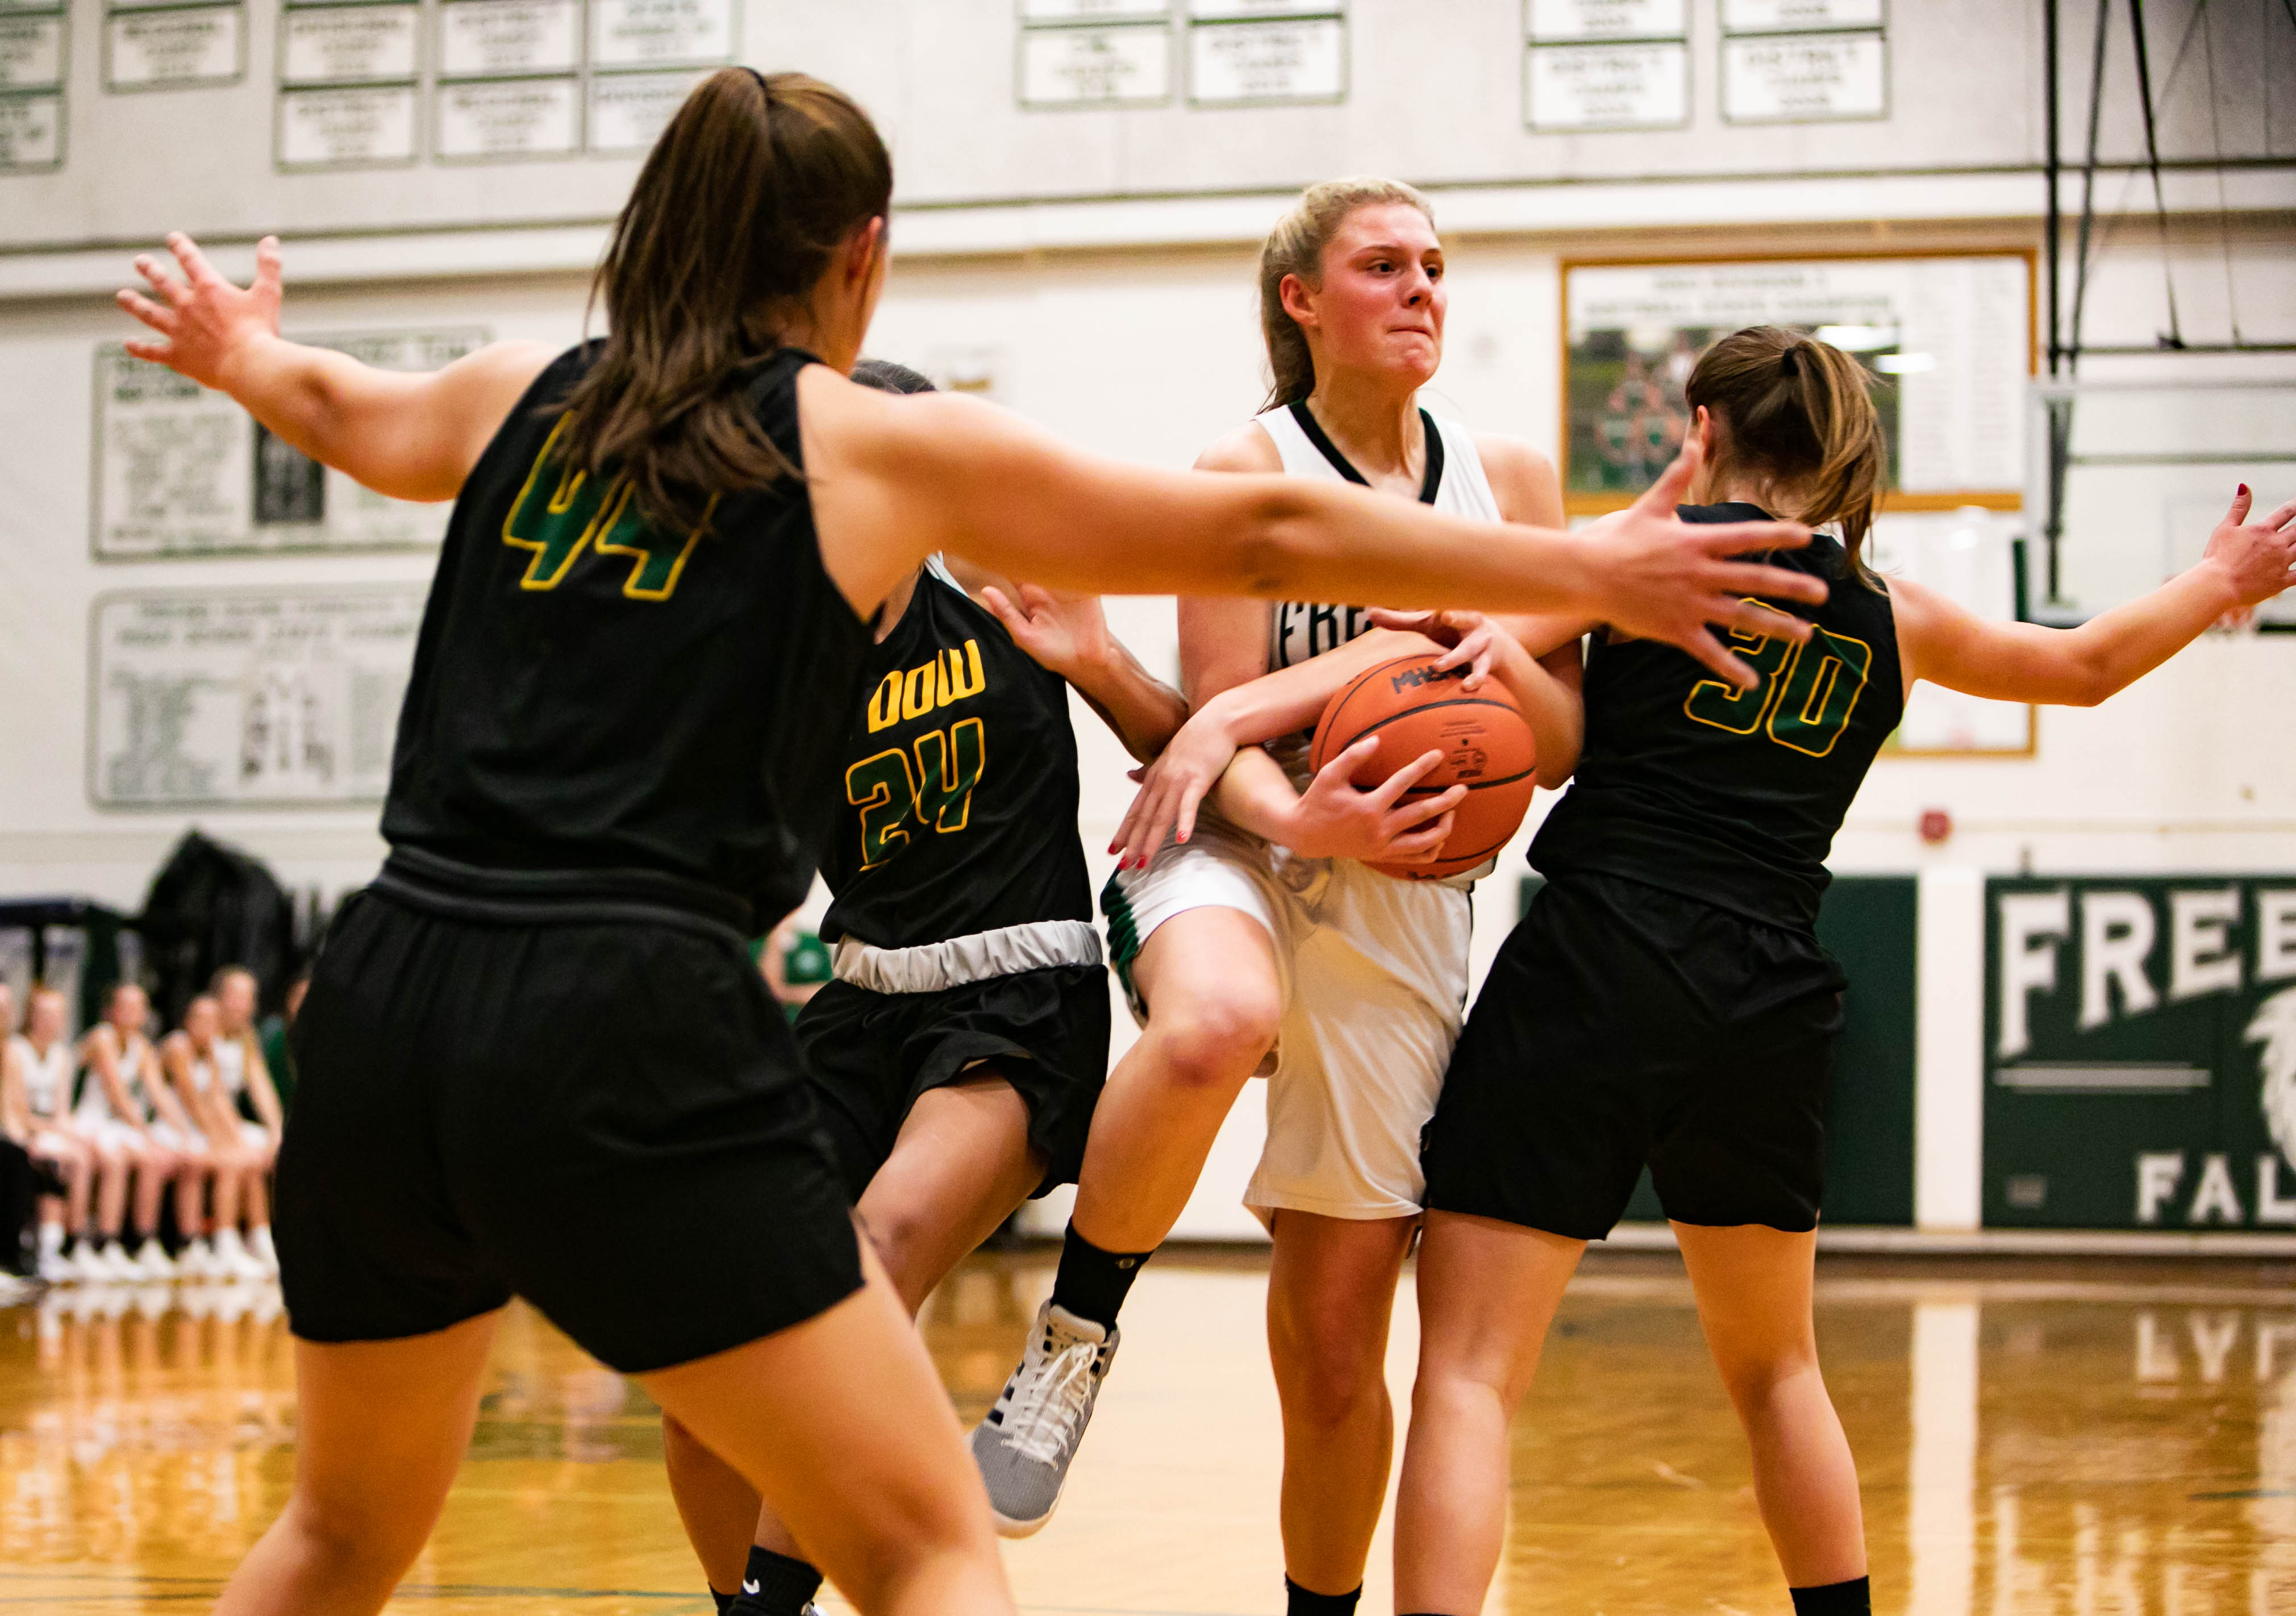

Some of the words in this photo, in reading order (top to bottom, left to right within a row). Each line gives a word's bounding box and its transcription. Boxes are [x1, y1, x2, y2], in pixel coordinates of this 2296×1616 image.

[868, 639, 986, 734] DOW
[1684, 596, 1872, 757] 30
[845, 717, 986, 872] 24
[2137, 1150, 2296, 1223] FAL
